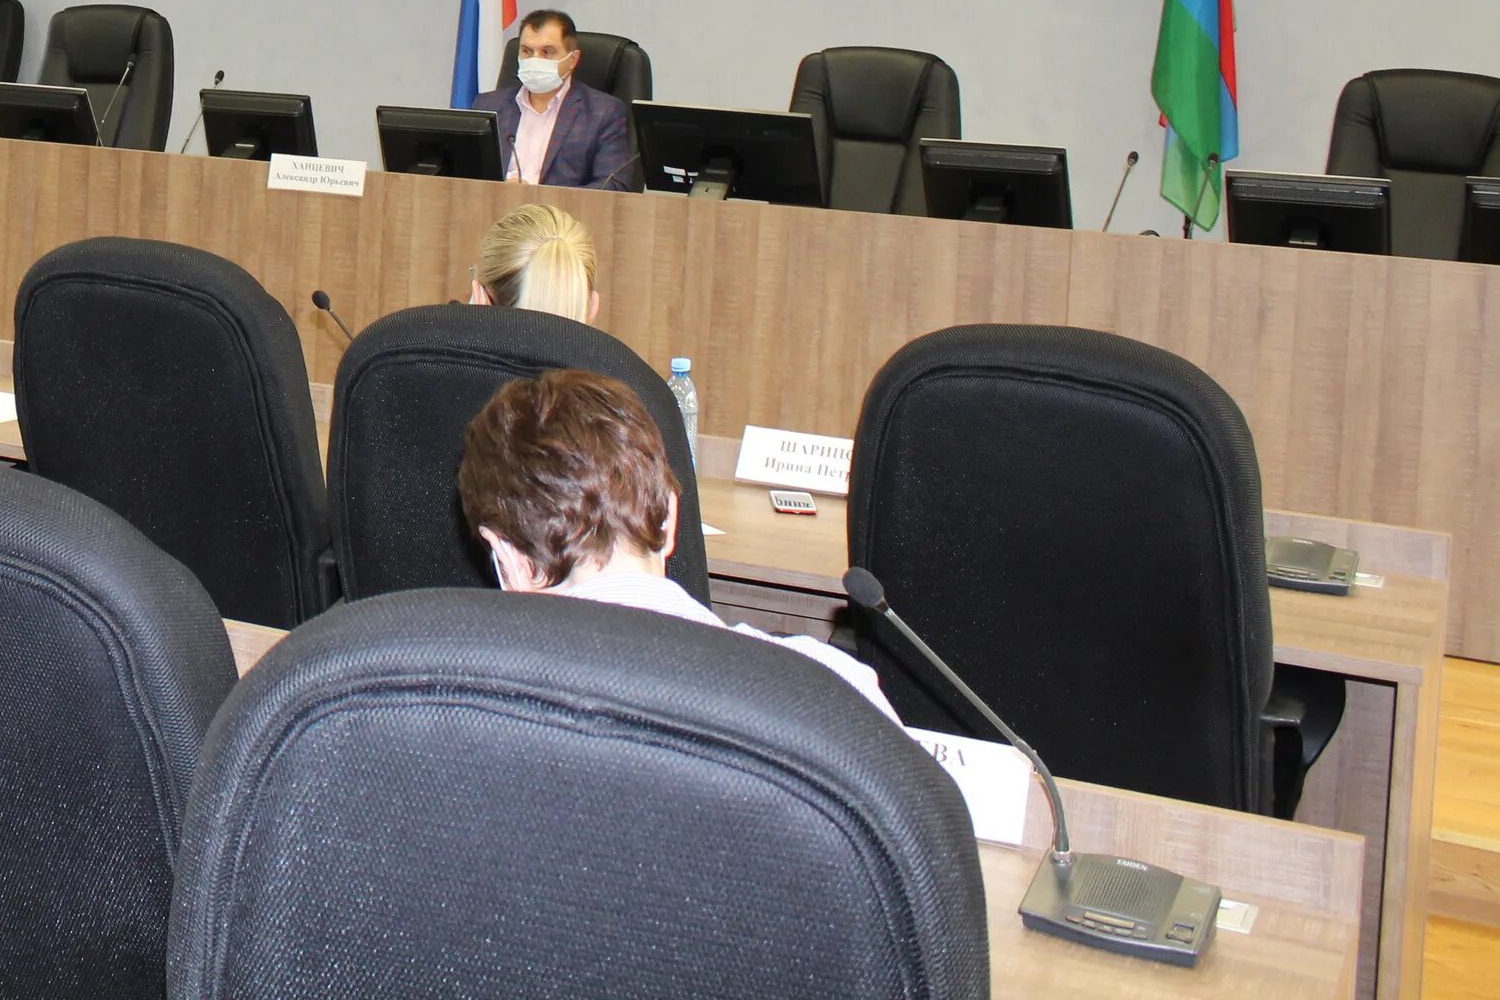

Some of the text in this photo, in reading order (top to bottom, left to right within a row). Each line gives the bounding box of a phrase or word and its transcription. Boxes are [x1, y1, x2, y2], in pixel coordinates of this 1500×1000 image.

[292, 161, 344, 174] ХАНЦЕВИЧ
[275, 172, 359, 187] Александр Юрьевич
[764, 457, 812, 474] Ирина
[1116, 859, 1148, 871] TAIDEN
